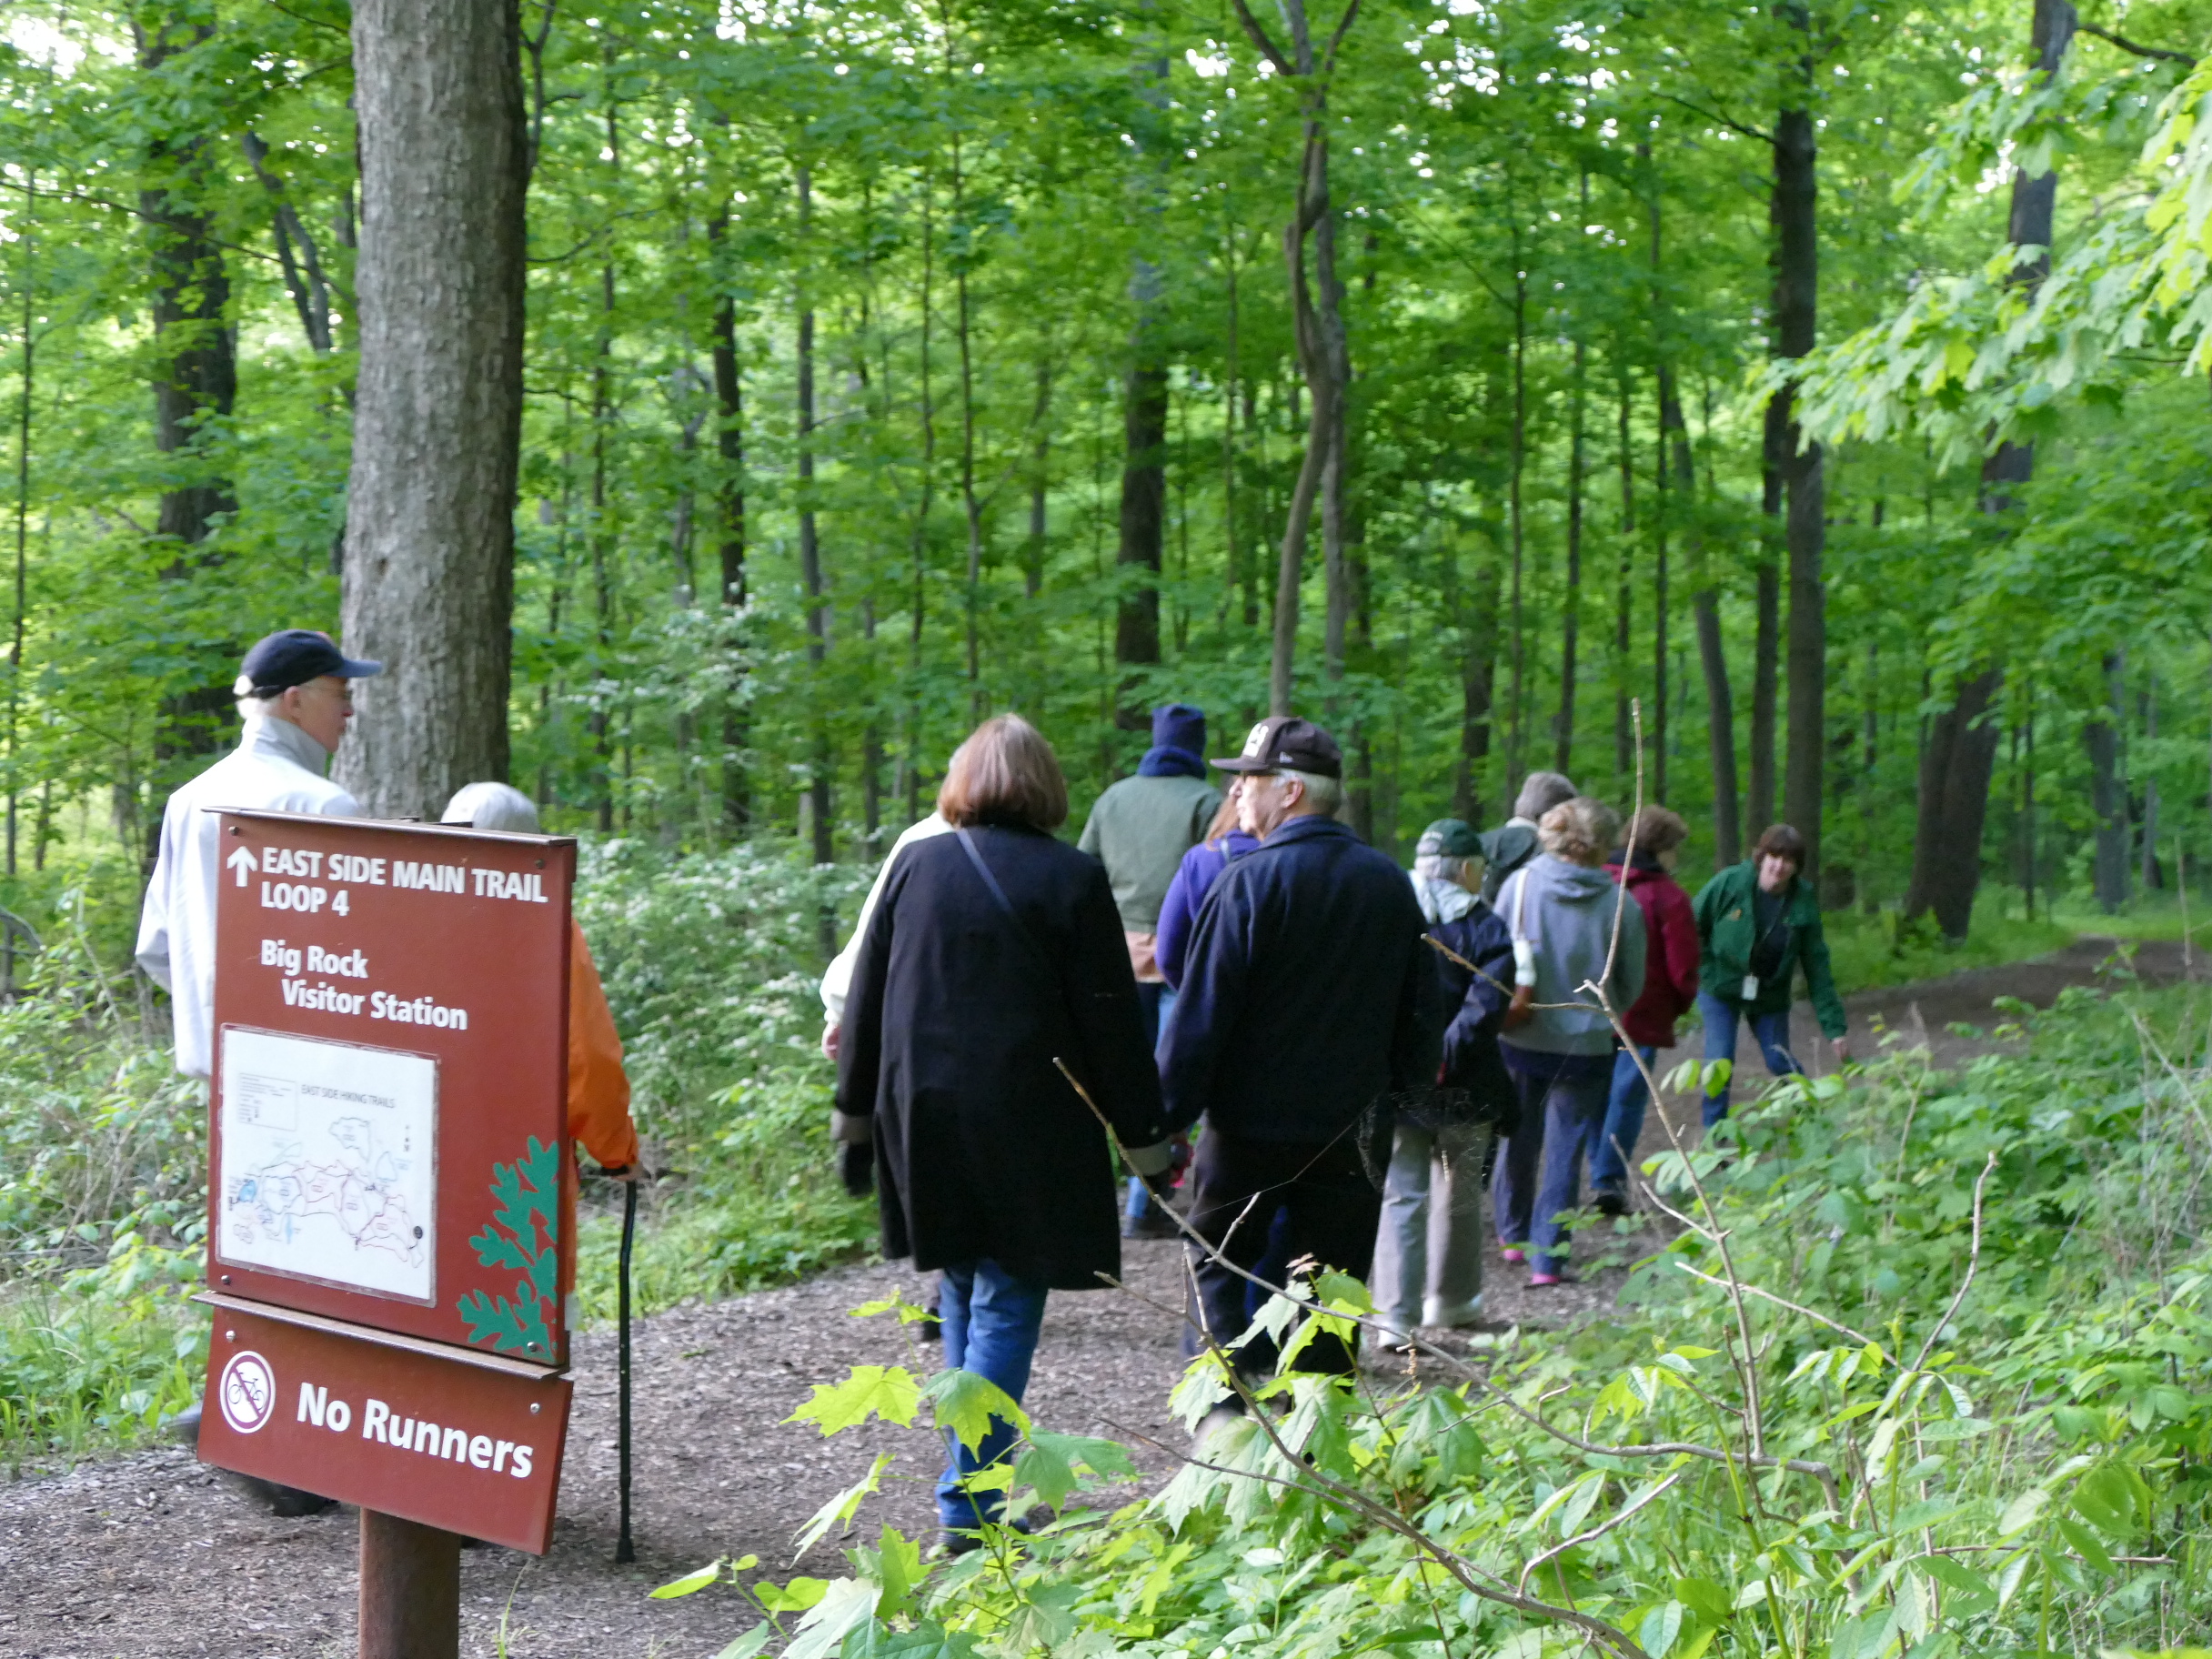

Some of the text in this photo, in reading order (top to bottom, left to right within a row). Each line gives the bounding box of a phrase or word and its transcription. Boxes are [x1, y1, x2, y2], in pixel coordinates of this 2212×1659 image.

[262, 847, 548, 903] EAST SIDE MAIN TRAIL
[261, 881, 350, 917] LOOP 4
[261, 939, 368, 979] Big Rock
[281, 979, 468, 1031] Visitor Station
[301, 1084, 396, 1109] EAST SIDE HIKING TRAILS
[297, 1382, 533, 1478] No Runners
